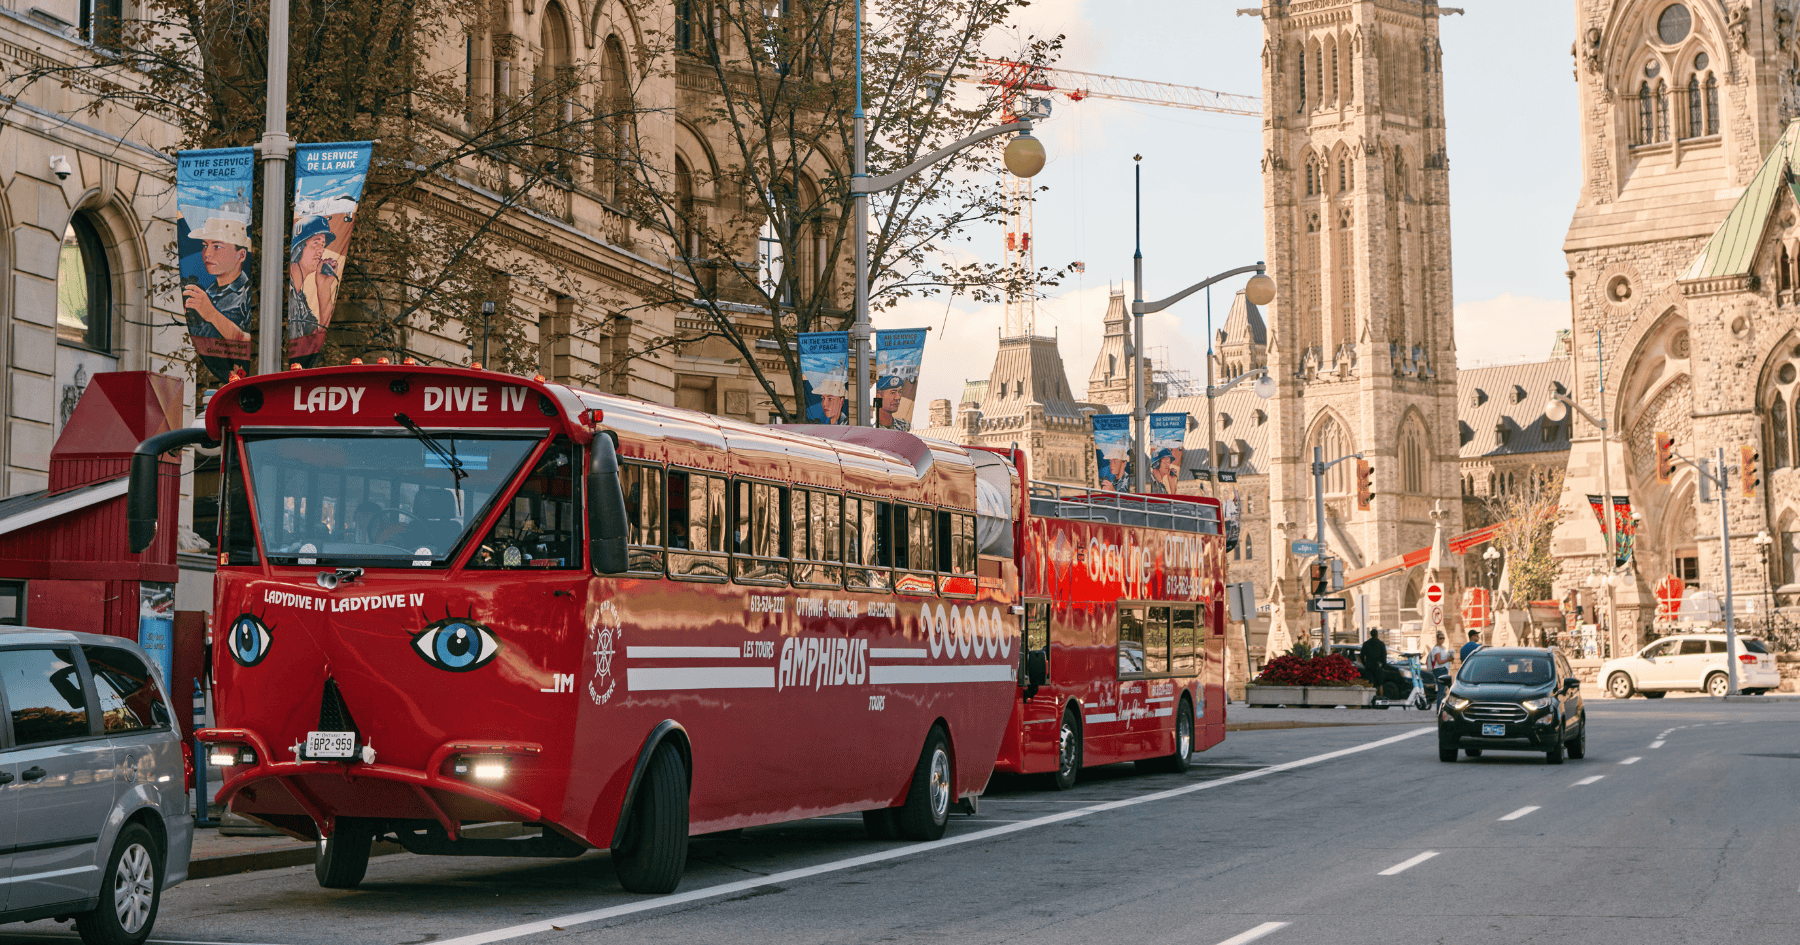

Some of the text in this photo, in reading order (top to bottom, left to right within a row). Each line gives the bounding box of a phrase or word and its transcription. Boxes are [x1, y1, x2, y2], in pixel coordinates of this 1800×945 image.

[182, 157, 250, 168] IN THE SERVICE
[307, 151, 358, 161] AU SERVICE
[307, 160, 356, 171] DE LA PAIX
[193, 167, 236, 177] OF PEACE
[293, 386, 529, 415] LADY DIVE IV
[1164, 534, 1204, 568] OTTAWA
[264, 589, 327, 611] LADYDIVE IV
[330, 593, 425, 613] LADYDIVE IV
[750, 595, 785, 613] 613-524-2221
[796, 597, 823, 618] OTTAWA
[743, 640, 774, 659] LES TOURS
[778, 637, 868, 693] AMPHIBUS
[868, 695, 885, 712] TOURS
[313, 738, 352, 751] BP2 959
